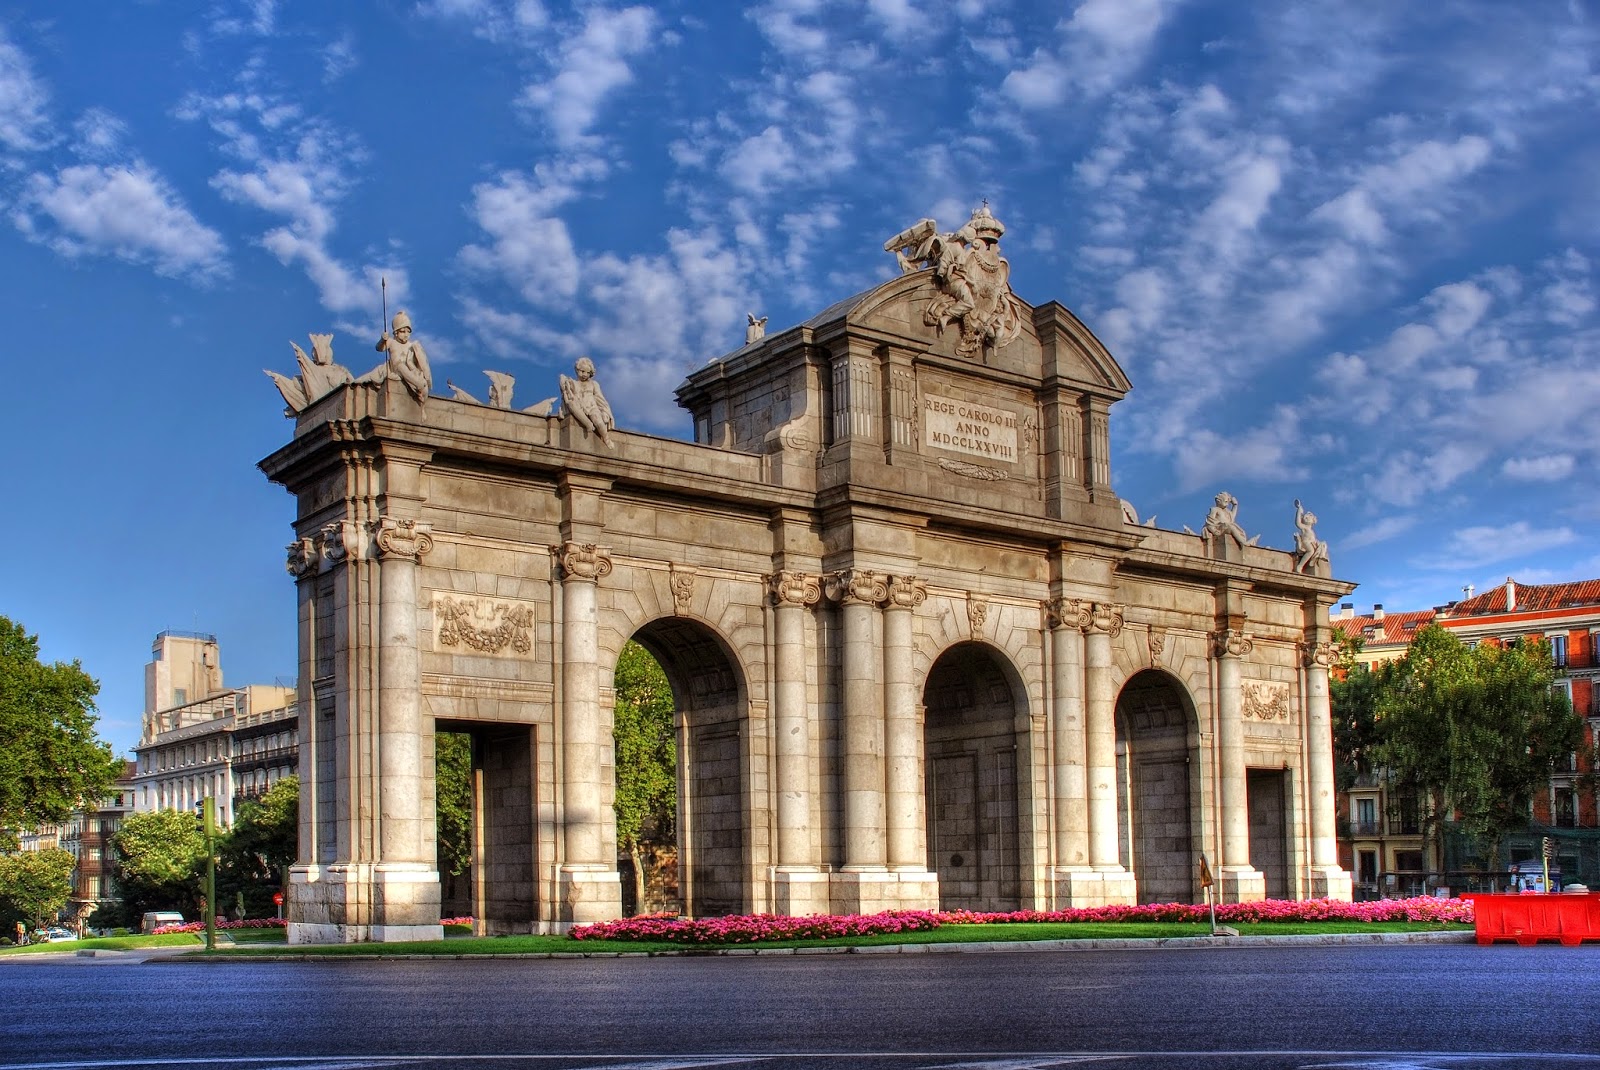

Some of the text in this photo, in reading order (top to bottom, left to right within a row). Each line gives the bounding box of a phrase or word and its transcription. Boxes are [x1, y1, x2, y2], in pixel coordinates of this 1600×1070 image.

[925, 400, 1018, 429] REGE CAROLO III
[956, 422, 990, 437] ANNO
[932, 432, 1012, 457] MDCCLXXVIII
